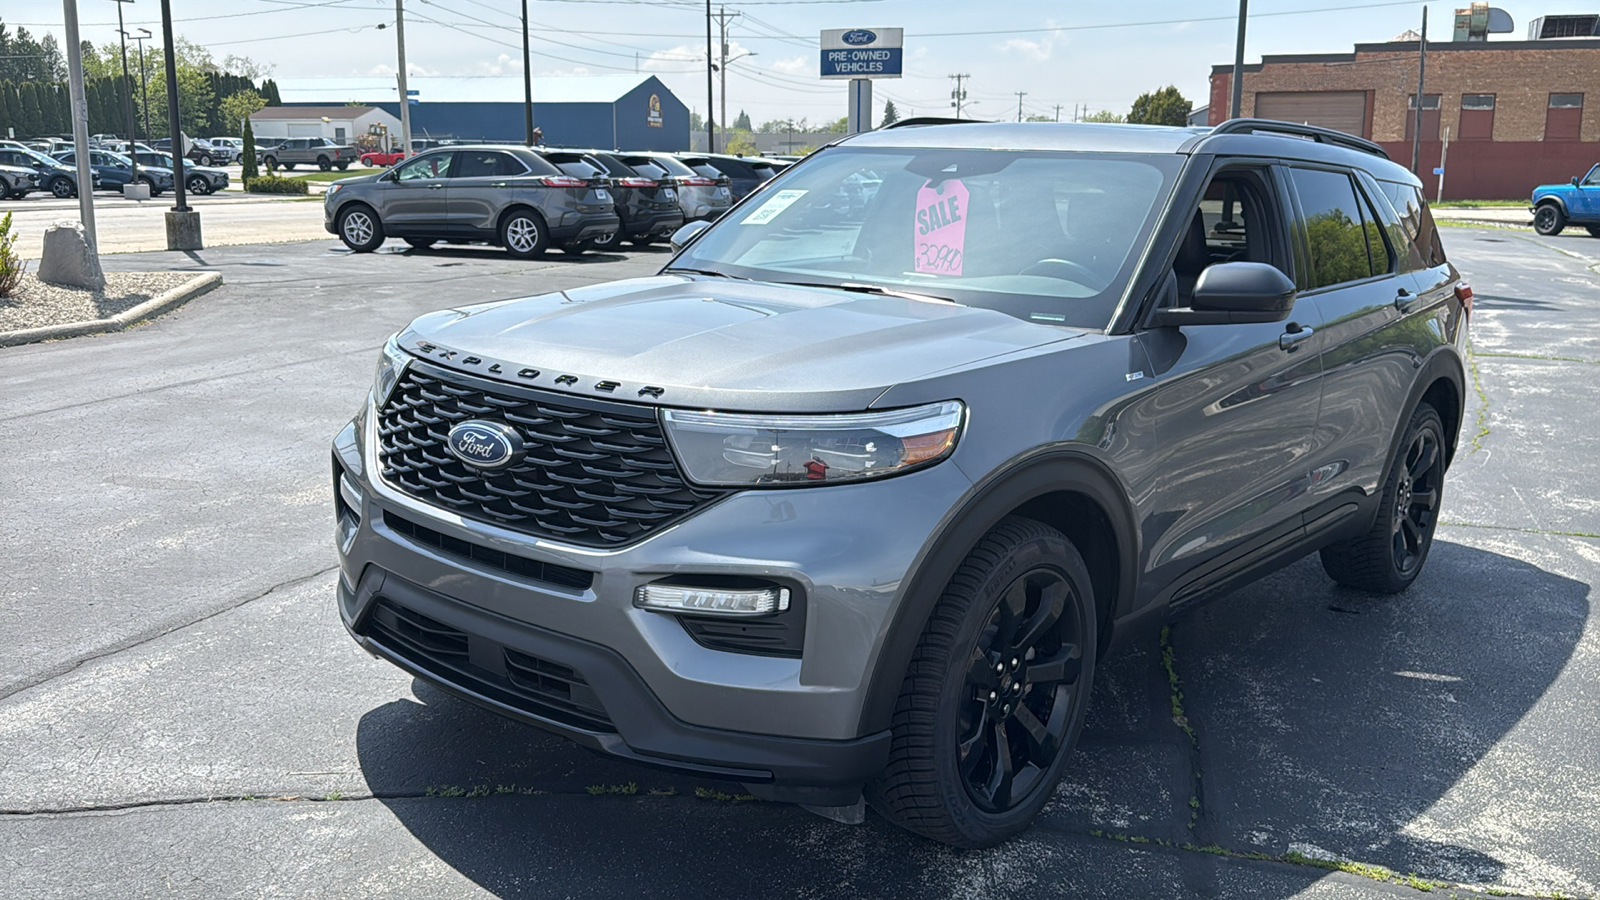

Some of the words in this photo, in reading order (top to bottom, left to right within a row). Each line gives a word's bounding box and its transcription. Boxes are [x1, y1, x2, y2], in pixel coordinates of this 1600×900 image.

[848, 32, 869, 43] Ford
[828, 50, 891, 61] PRE-OWNED
[834, 62, 883, 73] VEHICLES
[917, 195, 962, 236] SALE
[418, 343, 665, 399] EXPLORER
[458, 430, 495, 459] Ford
